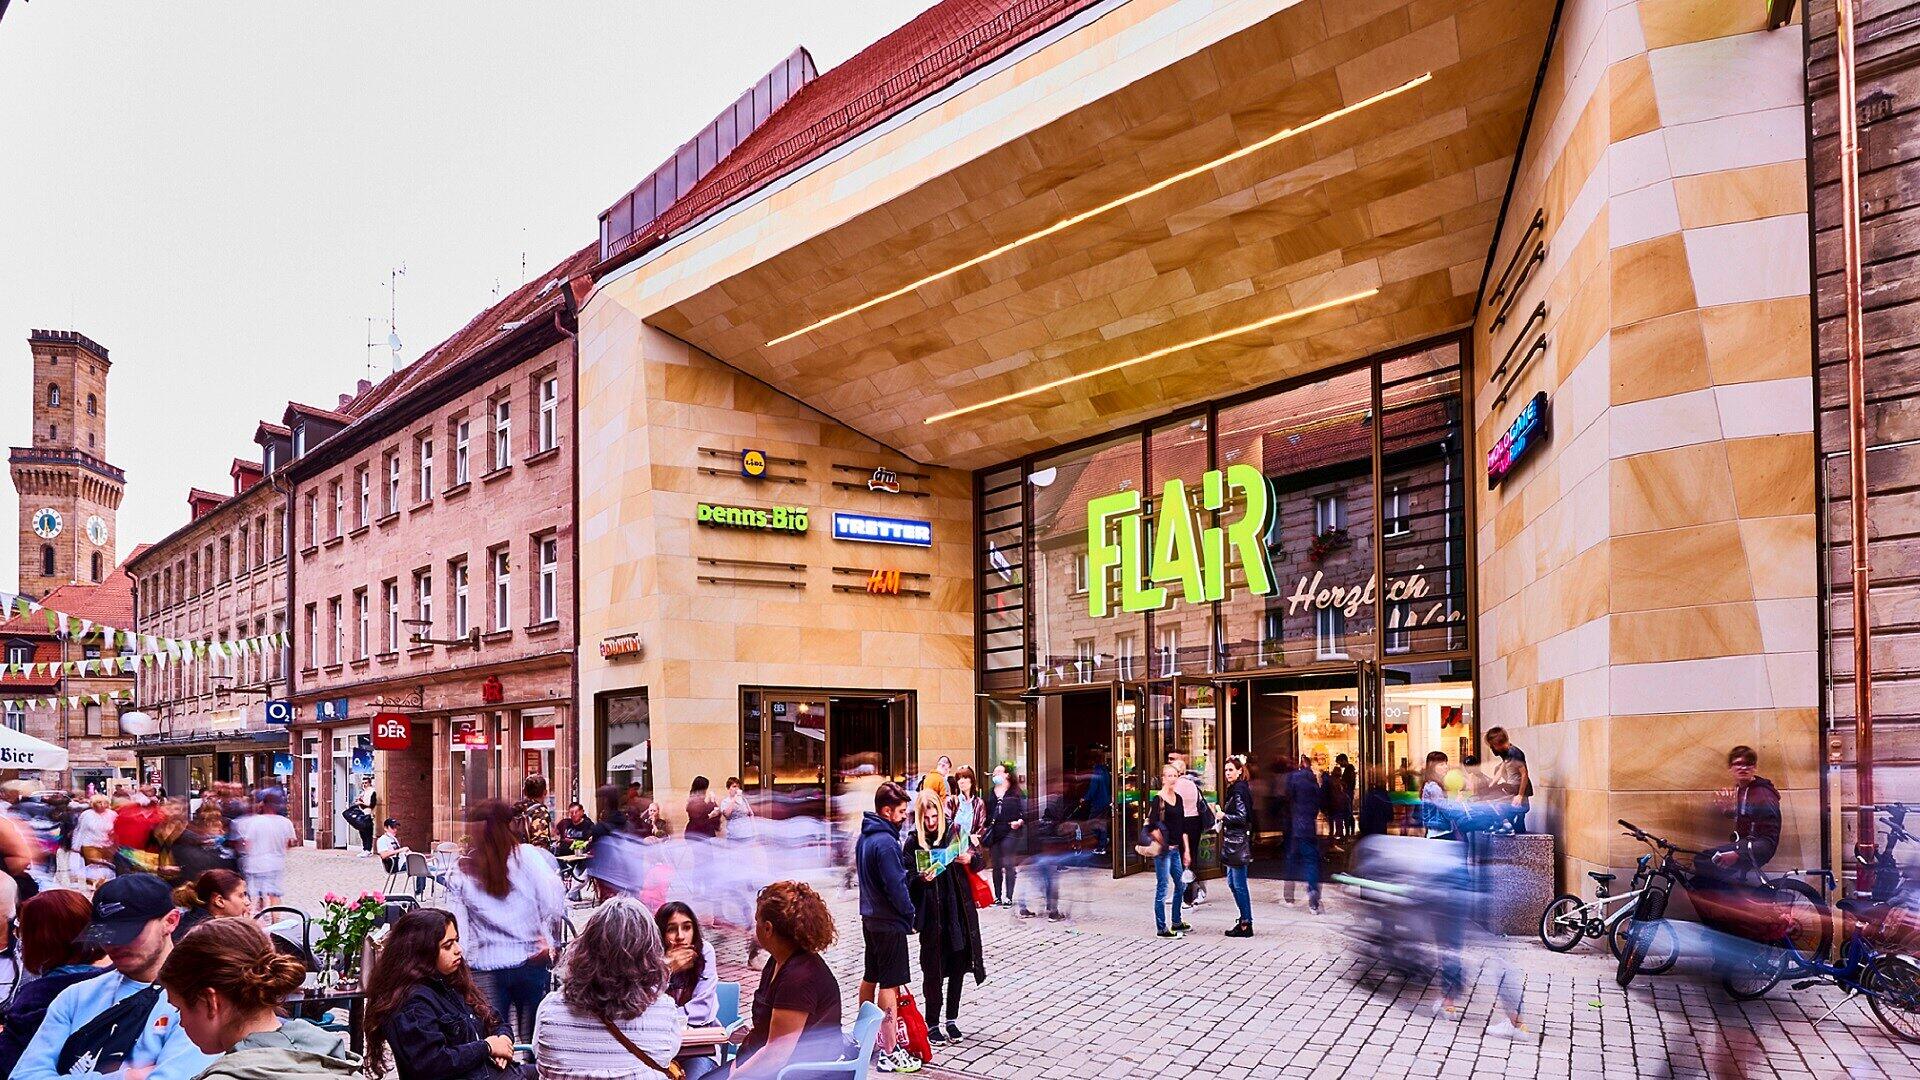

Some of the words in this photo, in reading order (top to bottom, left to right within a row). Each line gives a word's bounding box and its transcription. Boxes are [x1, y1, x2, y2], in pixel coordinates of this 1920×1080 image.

[872, 467, 898, 483] dm
[836, 517, 930, 541] TRETTER
[866, 568, 901, 595] H&M
[1287, 564, 1430, 618] Herzlch
[377, 720, 407, 739] DER
[0, 747, 34, 763] Bier
